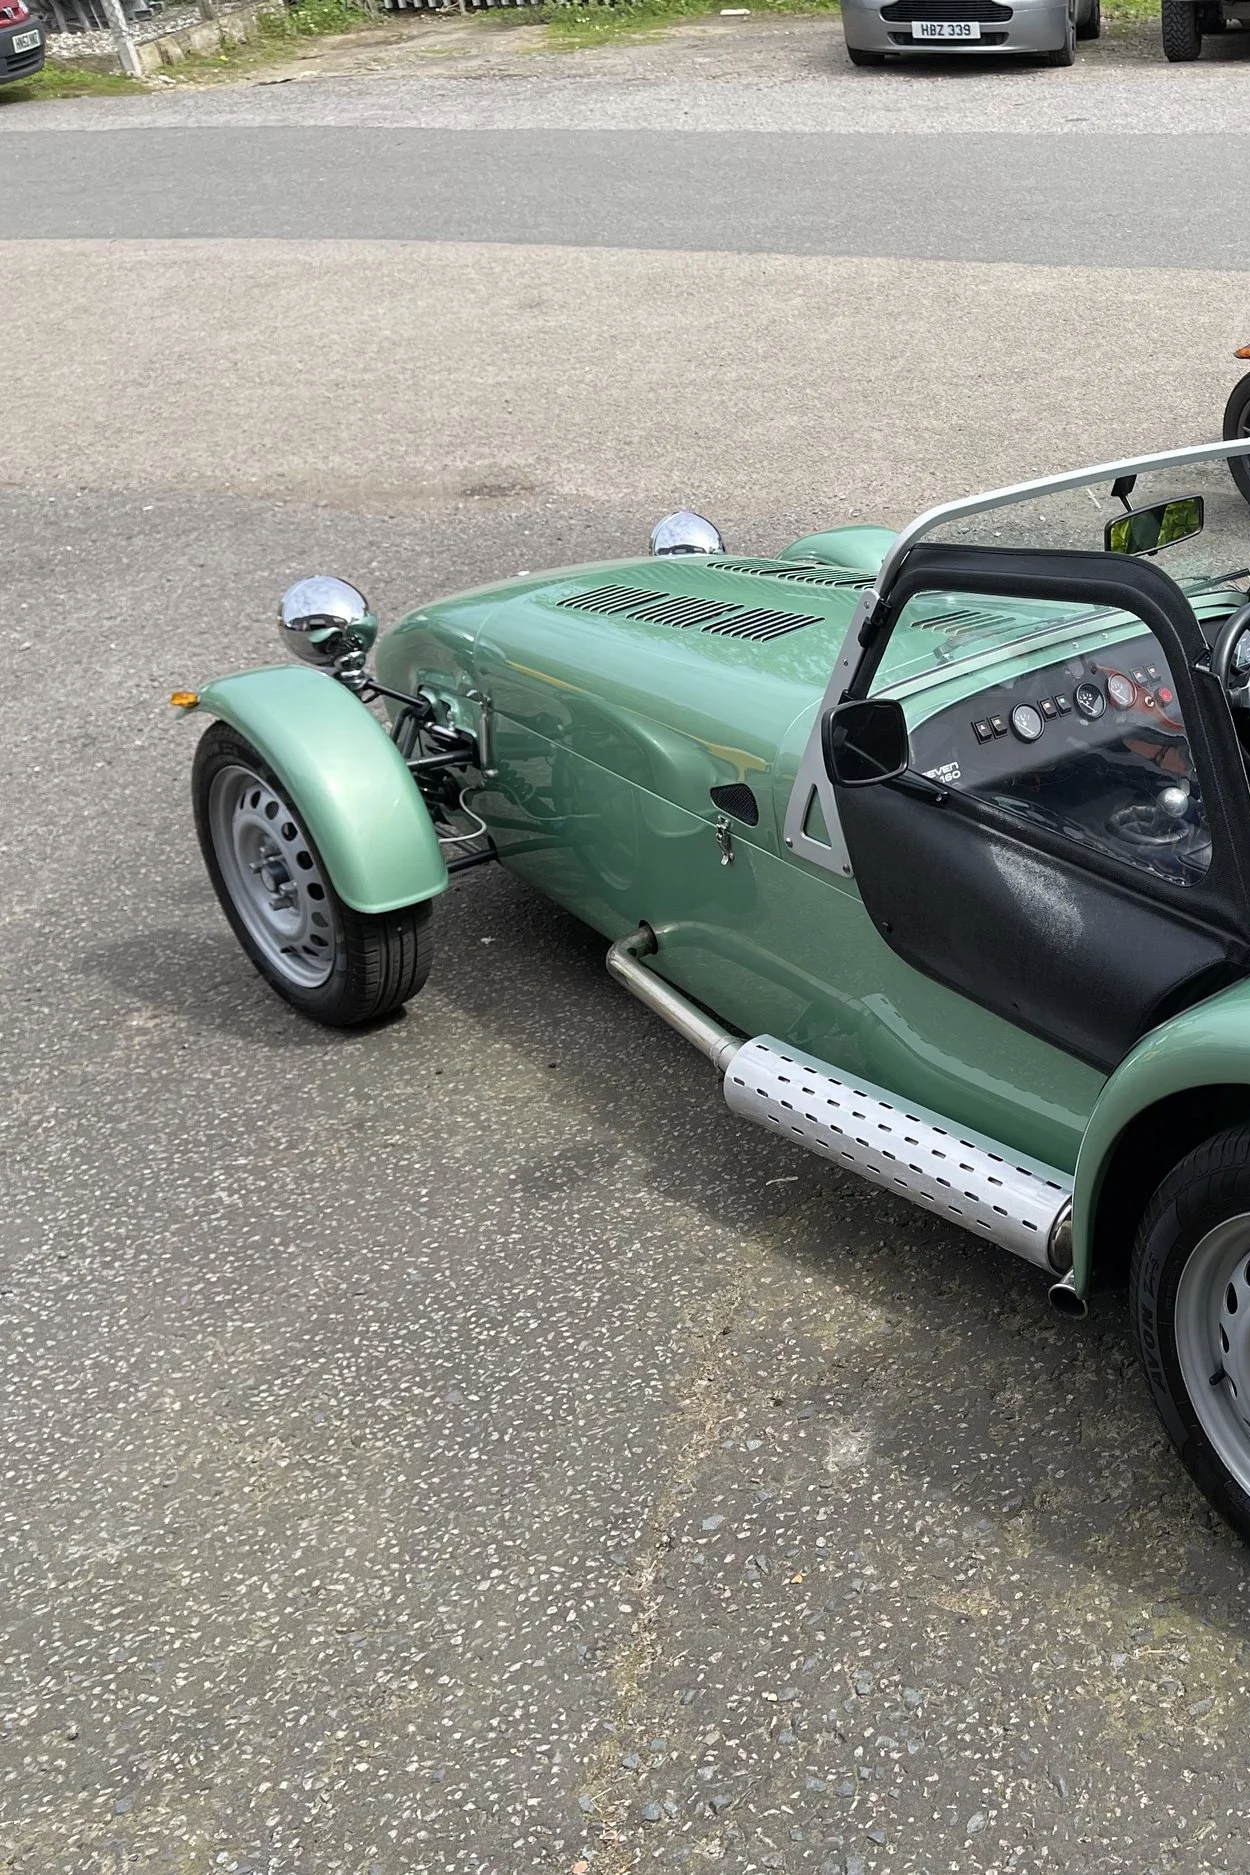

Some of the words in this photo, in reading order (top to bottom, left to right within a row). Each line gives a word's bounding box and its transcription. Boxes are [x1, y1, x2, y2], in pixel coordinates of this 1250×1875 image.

[921, 24, 945, 36] HBZ
[948, 24, 971, 36] 339
[940, 770, 961, 783] 160
[1141, 1302, 1168, 1394] AVON
